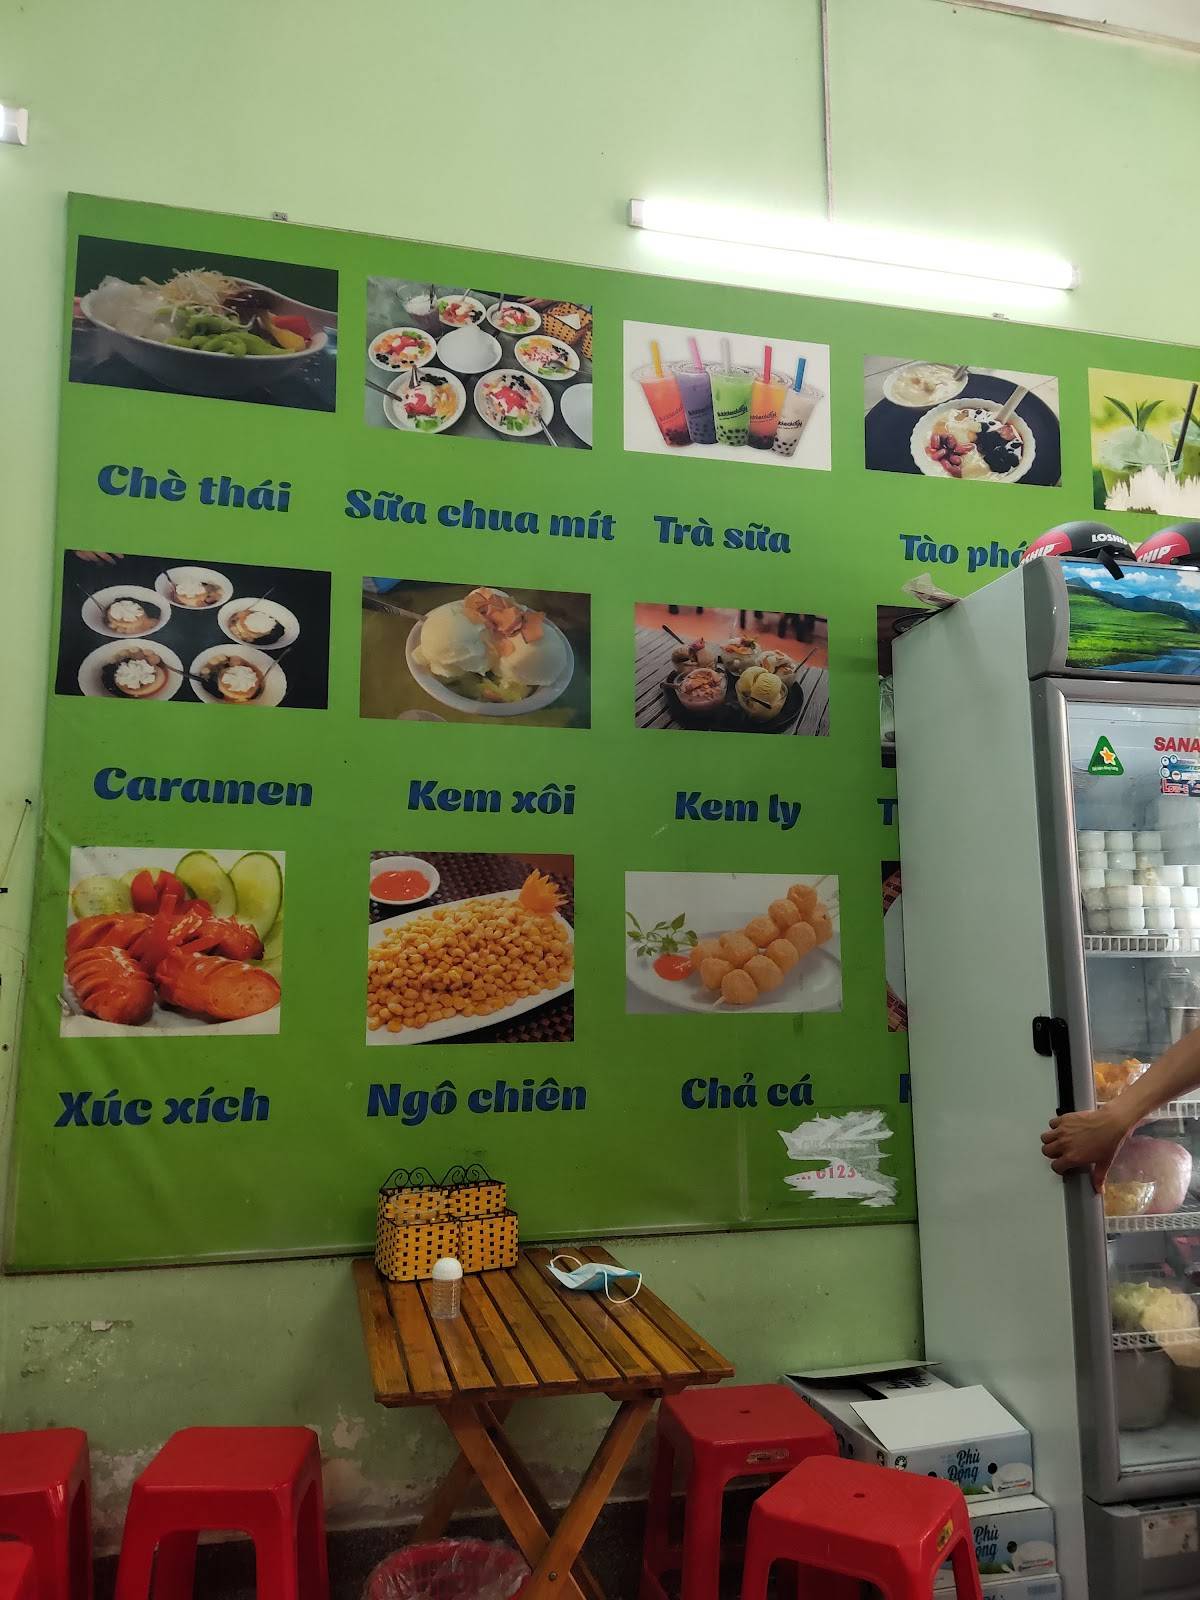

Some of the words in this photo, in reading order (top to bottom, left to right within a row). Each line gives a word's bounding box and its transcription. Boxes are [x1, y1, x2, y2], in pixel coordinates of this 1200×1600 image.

[97, 464, 186, 502] Chè
[198, 475, 291, 513] thái
[344, 489, 428, 525] Sữa
[438, 499, 539, 535] chua
[550, 509, 617, 541] mít
[654, 514, 715, 548] Trà
[722, 522, 791, 554] sữa
[899, 533, 959, 565] Tào
[93, 767, 313, 807] Caramen
[408, 779, 502, 813] Kem
[511, 782, 576, 815] xôi
[675, 791, 759, 823] Kem
[769, 793, 802, 831] ly
[54, 1088, 152, 1128] Xúc
[162, 1086, 270, 1125] xích
[367, 1080, 457, 1127] Ngô
[468, 1076, 587, 1114] chiên
[681, 1072, 758, 1109] Chả
[767, 1073, 815, 1107] cá
